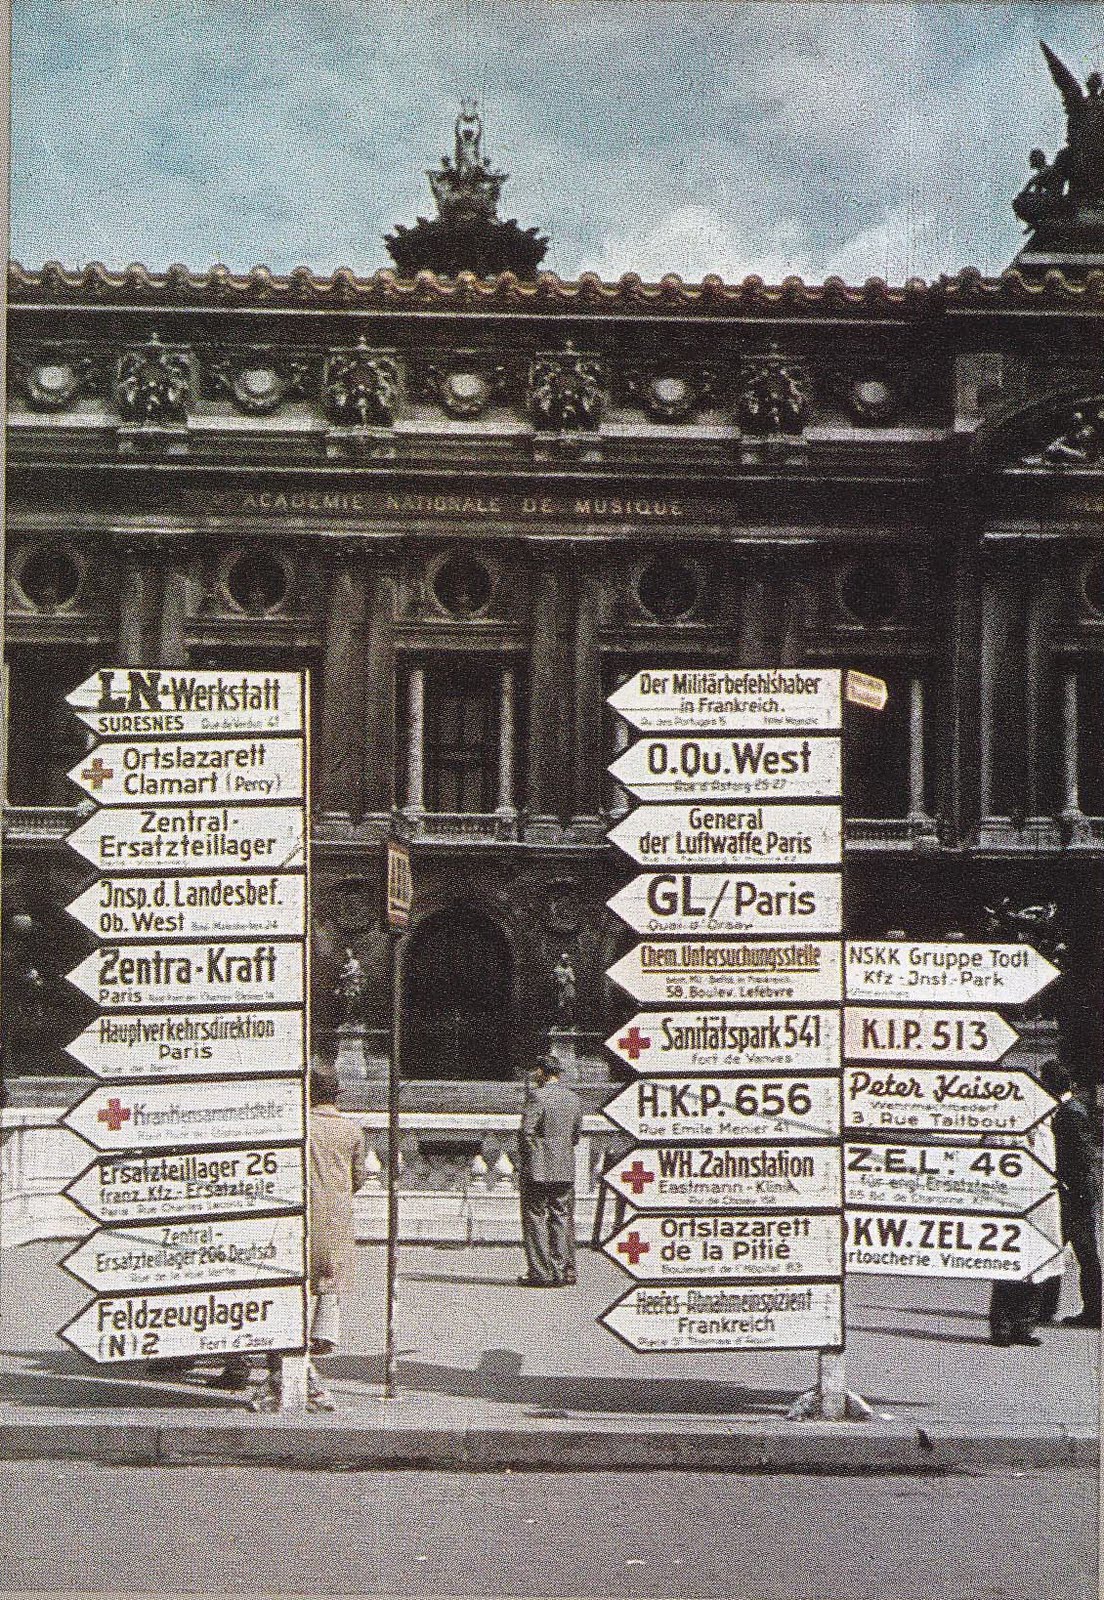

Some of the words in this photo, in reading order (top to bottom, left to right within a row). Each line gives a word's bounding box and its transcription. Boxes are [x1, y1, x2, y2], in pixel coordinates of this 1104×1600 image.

[640, 673, 669, 695] Der
[672, 671, 822, 696] Militärbefehlshaber
[680, 697, 694, 714] in
[98, 715, 185, 733] SURESNES
[123, 744, 266, 771] Ortslazarett
[124, 772, 218, 796] Clamart
[140, 810, 239, 834] Zentral-
[689, 808, 763, 830] General
[100, 833, 276, 861] Ersatzteillager
[639, 831, 669, 854] der
[766, 832, 812, 855] Paris
[132, 911, 185, 932] West
[849, 946, 900, 966] NSKK
[909, 947, 983, 971] Gruppe
[990, 949, 1029, 968] Todt
[99, 989, 142, 1003] Paris
[100, 1014, 275, 1046] Hauptverkehrsdirektion
[661, 1015, 782, 1053] Sanitätspark
[784, 1014, 821, 1048] 541
[932, 1020, 989, 1051] 513
[158, 1043, 213, 1060] Paris
[725, 1053, 741, 1065] de
[850, 1071, 925, 1101] Peter
[932, 1074, 1025, 1102] Kaiser
[638, 1083, 726, 1118] H.K.P.
[735, 1082, 812, 1117] 656
[639, 1123, 665, 1136] Rue
[880, 1112, 919, 1126] Rue
[929, 1112, 1017, 1128] Taitbout
[100, 1155, 239, 1187] Ersatzteillager
[246, 1152, 278, 1176] 26
[969, 1151, 1023, 1178] 46
[660, 1217, 811, 1238] Ortslazarett
[978, 1222, 1021, 1252] 22
[96, 1247, 198, 1273] Ersatzteillager
[660, 1239, 691, 1261] de
[702, 1240, 723, 1261] la
[732, 1239, 791, 1261] Pitié
[940, 1253, 1022, 1272] Vincennes
[98, 1294, 274, 1333] Feldzeuglager
[678, 1316, 775, 1334] Frankreich
